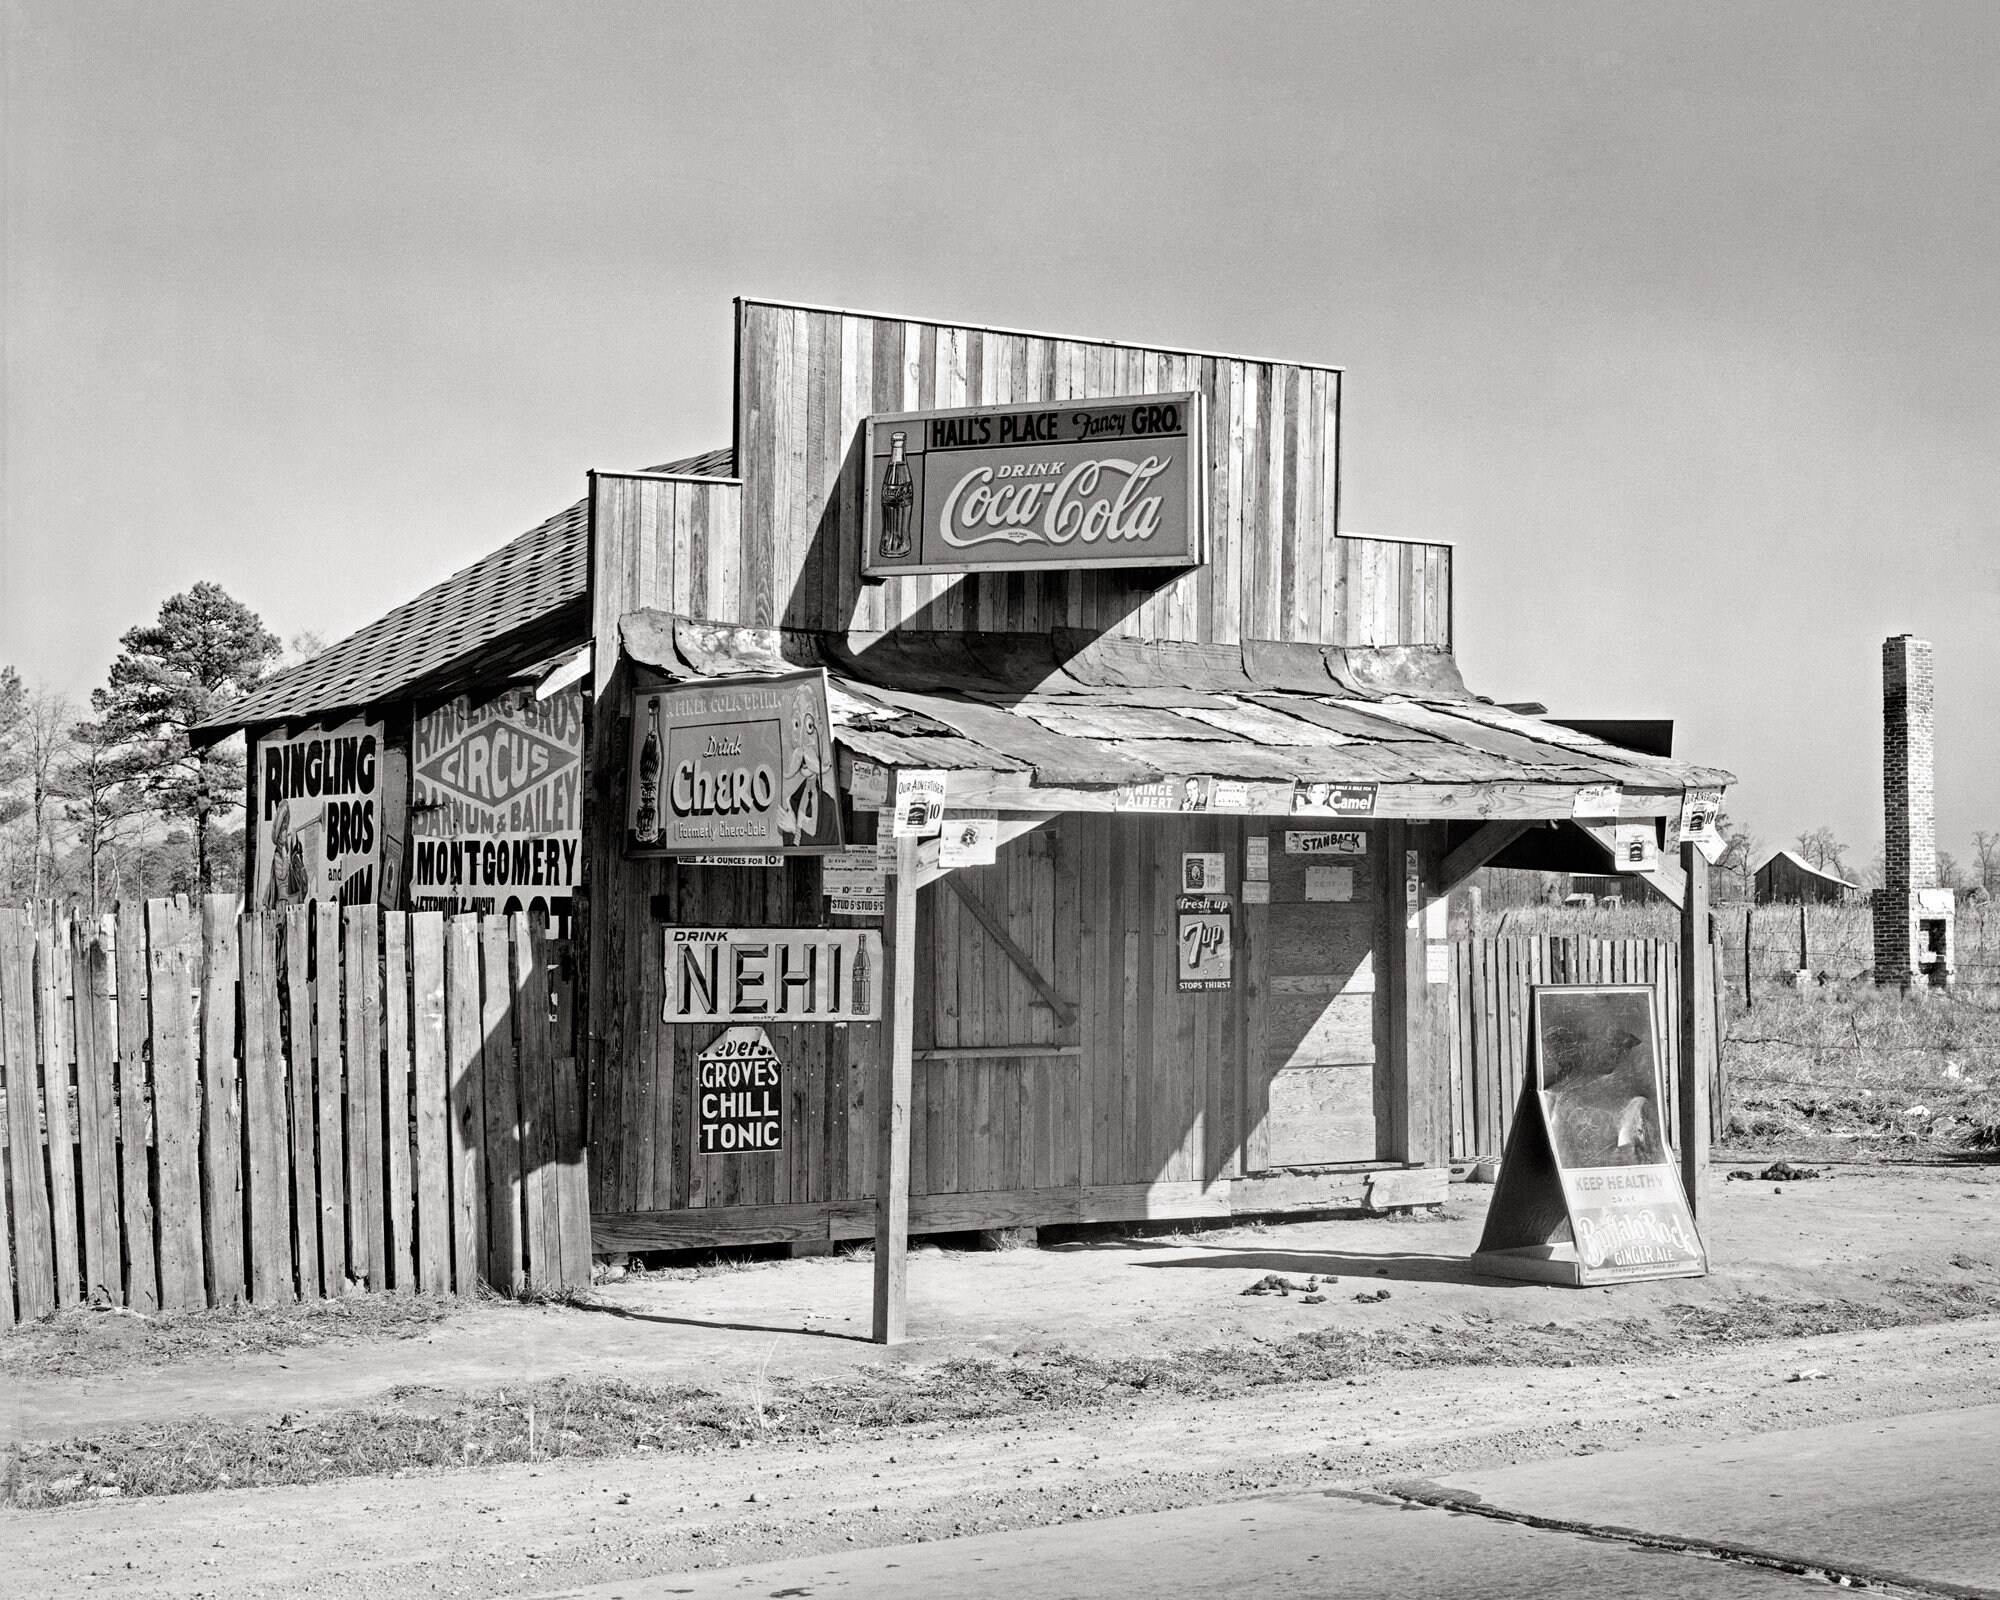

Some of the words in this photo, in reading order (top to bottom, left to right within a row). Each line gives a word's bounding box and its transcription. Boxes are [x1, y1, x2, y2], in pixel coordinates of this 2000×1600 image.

[932, 417, 991, 447] HALL'S
[1001, 413, 1058, 443] PLACE
[1072, 412, 1127, 440] Fancy
[1131, 405, 1182, 434] GRO.
[997, 462, 1066, 479] DRINK
[940, 455, 1173, 547] Coca-Cola
[703, 735, 742, 757] Drink
[441, 727, 549, 799] CIRCUS
[265, 735, 376, 821] RINGLING
[510, 764, 580, 833] BAILEY
[1126, 790, 1174, 808] ALBERT
[1329, 790, 1373, 810] Camel
[1577, 787, 1600, 798] Cmels
[327, 800, 373, 861] BROS
[328, 861, 342, 881] and
[417, 839, 577, 886] MONTGOMERY
[717, 857, 746, 865] OUNCES
[1181, 898, 1210, 909] fresh
[1214, 900, 1228, 912] up
[674, 932, 728, 942] DRINK
[677, 944, 841, 1014] NEHI
[1180, 982, 1203, 990] STOPS
[1205, 981, 1231, 989] THIRST
[702, 1091, 779, 1119] CHILL
[702, 1121, 779, 1150] TONIC
[1575, 1175, 1604, 1191] KEEP
[1607, 1174, 1663, 1190] HEALTHY
[1614, 1245, 1653, 1266] GINGER
[1656, 1245, 1675, 1262] ALE
